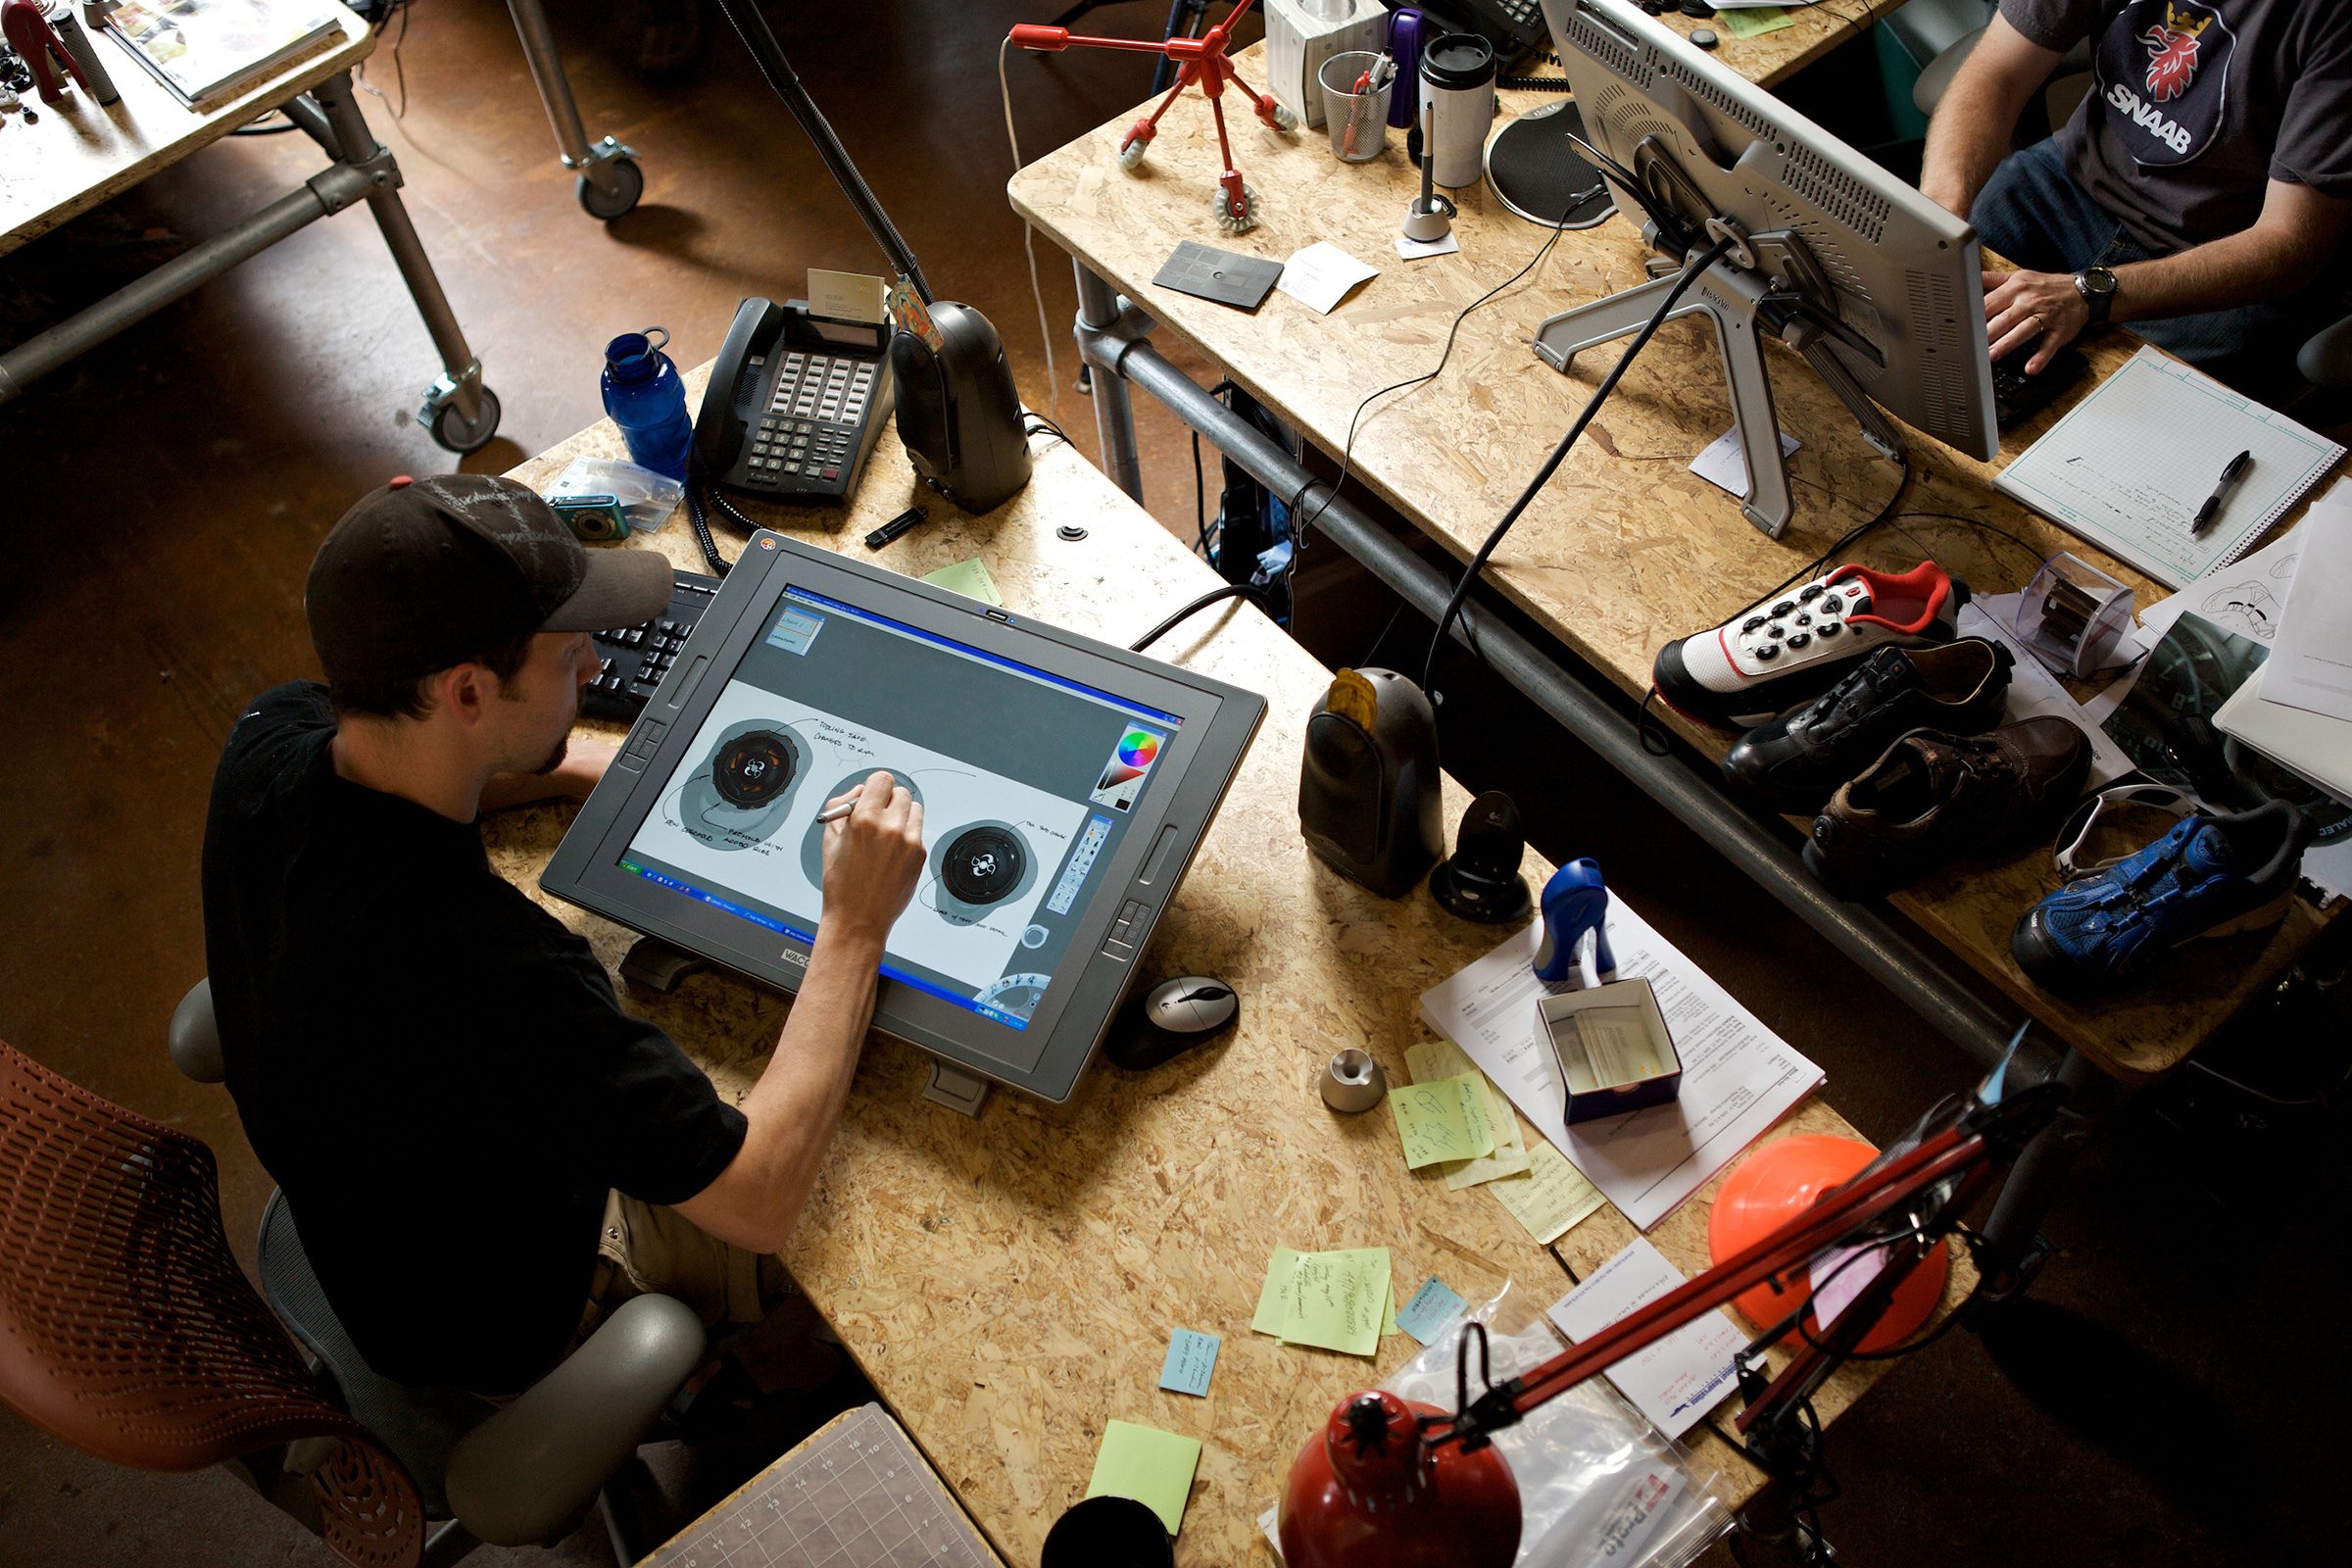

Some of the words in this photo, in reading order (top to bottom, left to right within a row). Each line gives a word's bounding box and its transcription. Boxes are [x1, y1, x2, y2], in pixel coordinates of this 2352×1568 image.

[2107, 83, 2192, 155] SNAAB
[849, 1441, 860, 1452] 16
[868, 1445, 880, 1455] 10
[821, 1459, 834, 1471] 15
[887, 1471, 895, 1480] 9
[794, 1480, 807, 1491] 14
[905, 1494, 912, 1503] 8
[767, 1499, 780, 1510] 13
[740, 1519, 753, 1530] 12
[922, 1519, 929, 1528] 7
[712, 1539, 725, 1550] 11
[941, 1544, 949, 1554] 6
